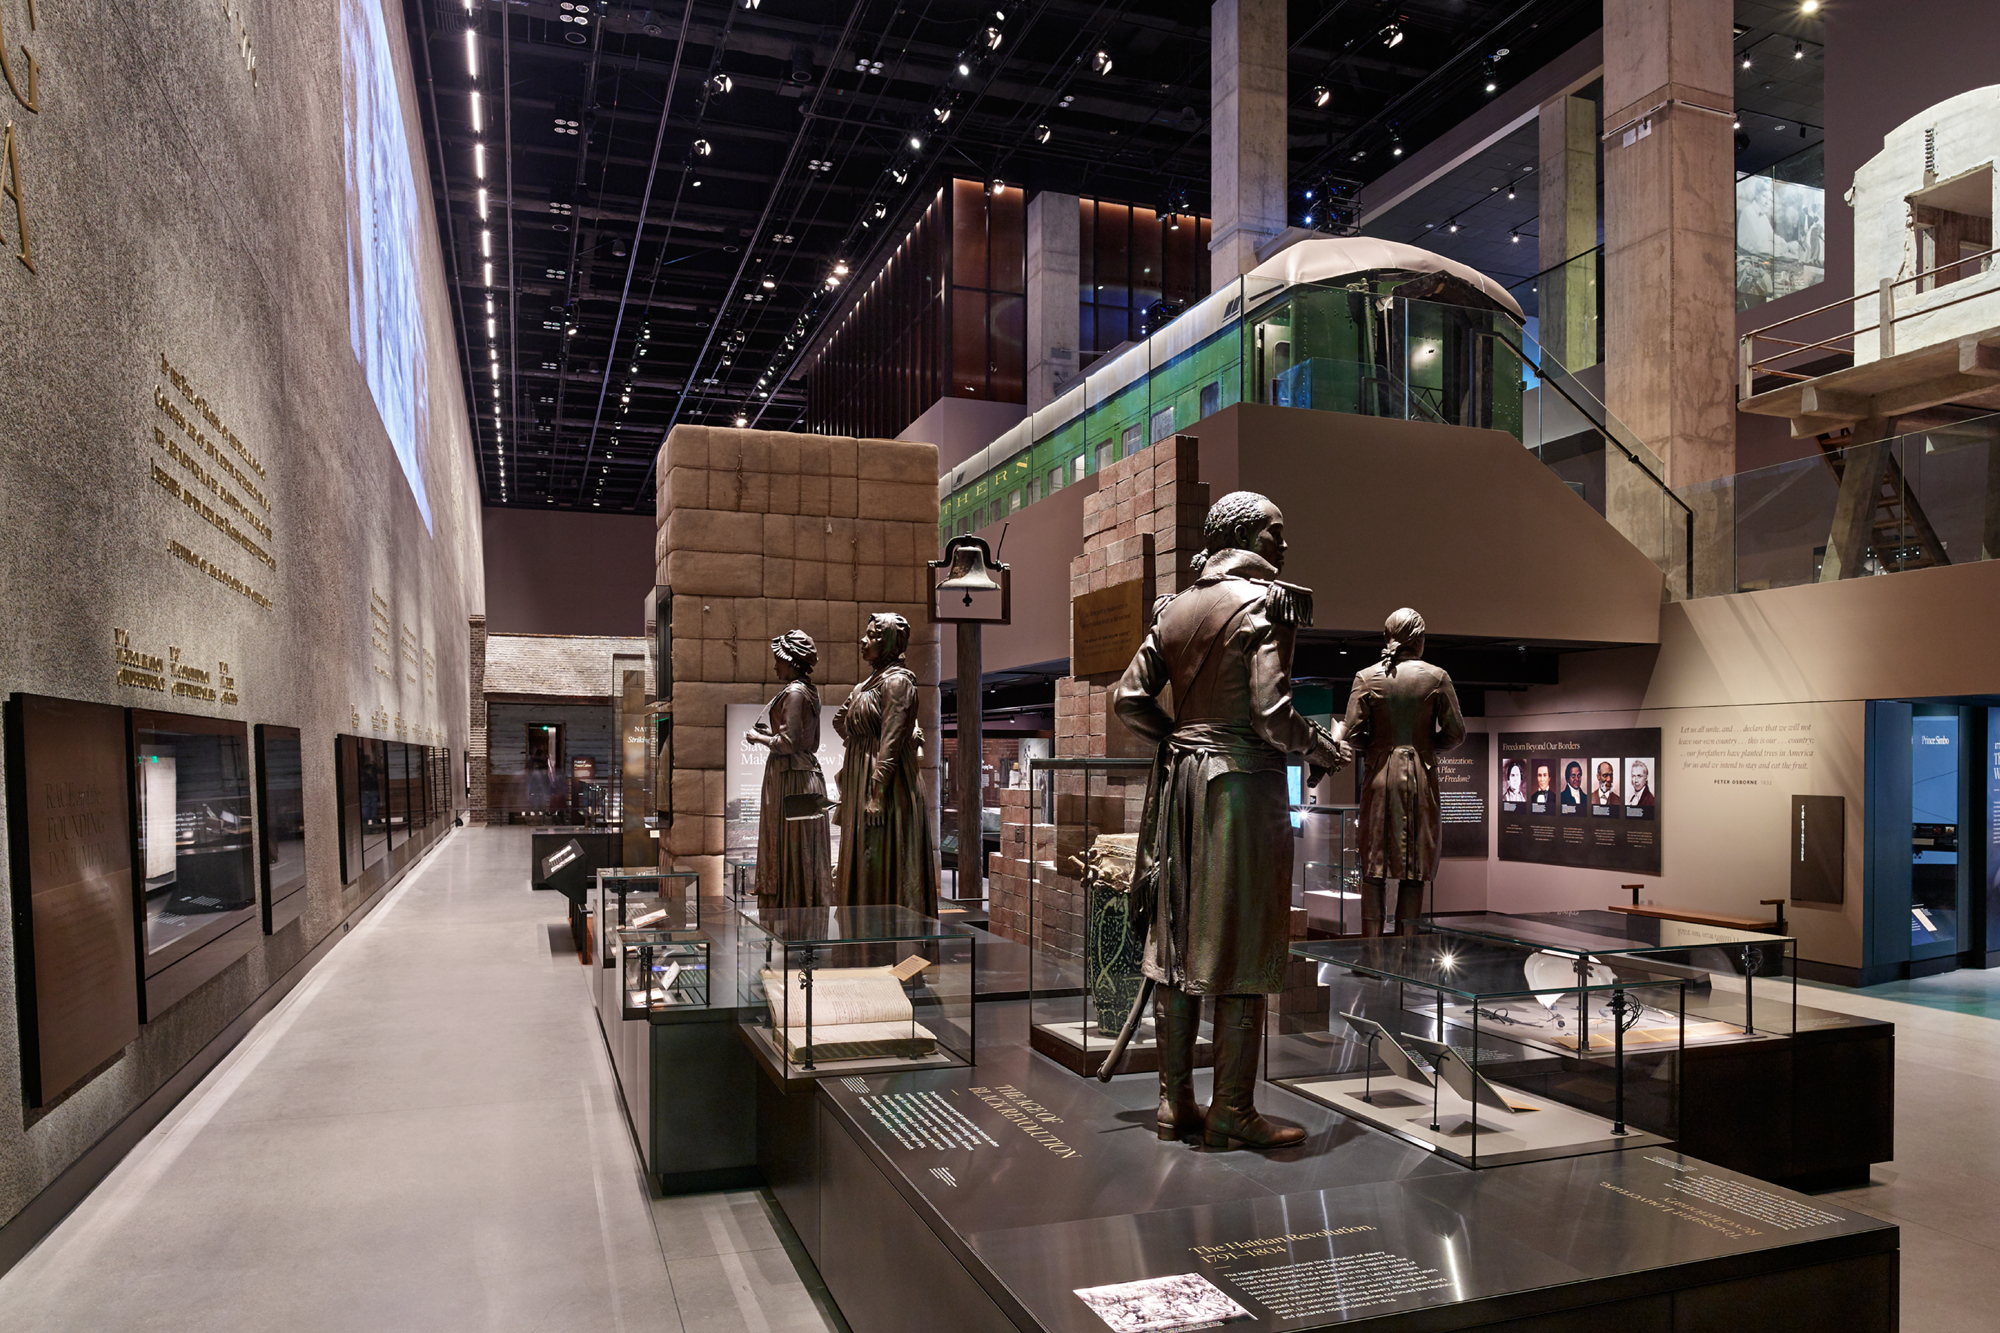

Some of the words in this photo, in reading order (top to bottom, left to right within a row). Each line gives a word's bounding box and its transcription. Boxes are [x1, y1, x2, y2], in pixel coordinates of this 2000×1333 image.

[1722, 725, 1733, 733] and
[1743, 725, 1764, 733] declare
[1716, 738, 1737, 746] country
[1788, 737, 1814, 745] country;
[1526, 743, 1546, 752] Beyond
[1546, 742, 1558, 750] Our
[1558, 742, 1580, 750] Borders
[1696, 750, 1726, 758] forefathers
[1741, 750, 1762, 758] planted
[1683, 761, 1691, 770] for
[1720, 761, 1737, 769] intend
[1745, 762, 1757, 770] stay
[1792, 761, 1808, 770] fruit.
[994, 1084, 1027, 1100] THE
[1013, 1100, 1048, 1113] AGE
[1036, 1112, 1064, 1123] OF
[968, 1086, 1012, 1109] BLACK
[997, 1108, 1083, 1159] REVOLUTION
[1188, 1245, 1224, 1255] The
[1227, 1238, 1287, 1250] Haitian
[1286, 1223, 1377, 1242] Revolution,
